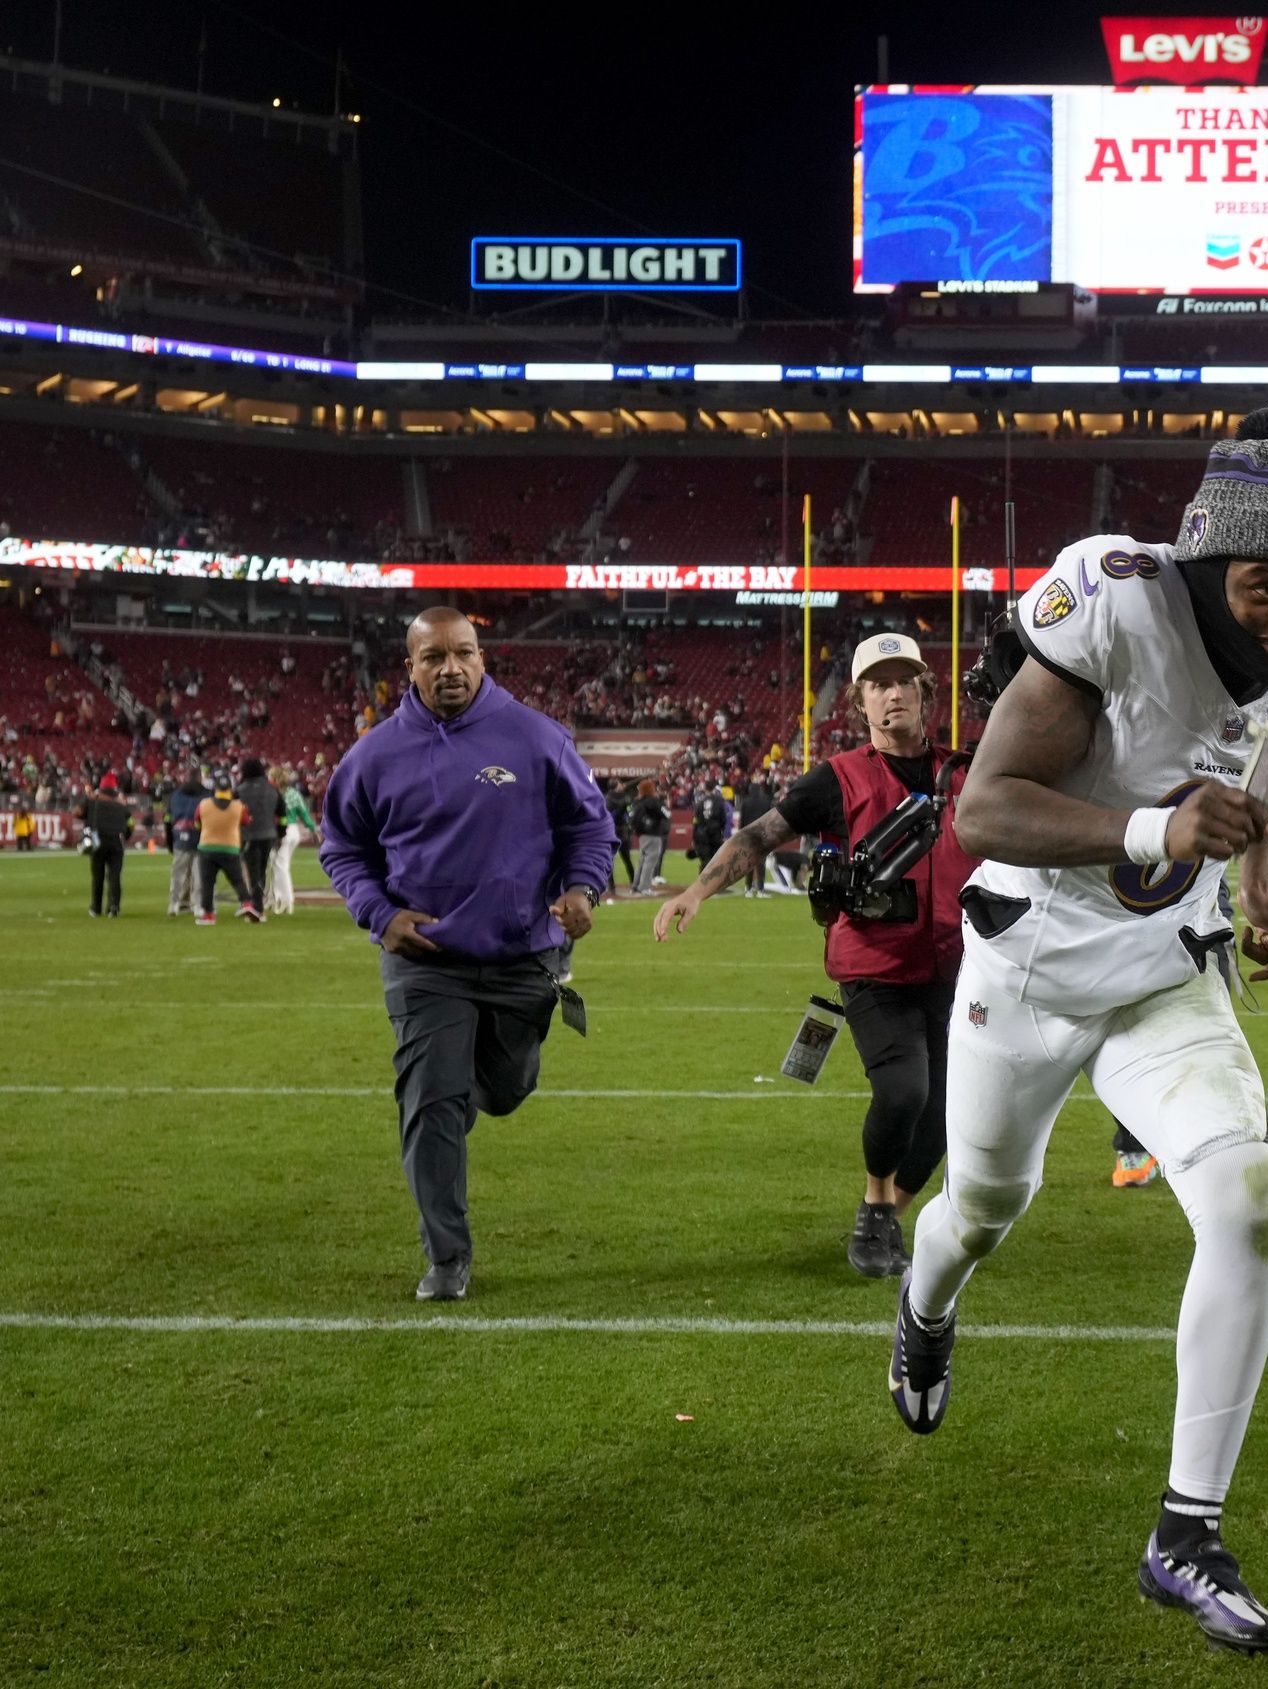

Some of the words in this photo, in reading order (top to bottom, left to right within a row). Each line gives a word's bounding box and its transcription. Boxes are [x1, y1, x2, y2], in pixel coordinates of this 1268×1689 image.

[1184, 299, 1257, 314] Foxconn
[1100, 550, 1161, 580] 8
[565, 565, 682, 589] FAITHFUL
[698, 566, 745, 589] THE
[749, 567, 798, 589] BAY
[1193, 762, 1243, 777] RAVENS
